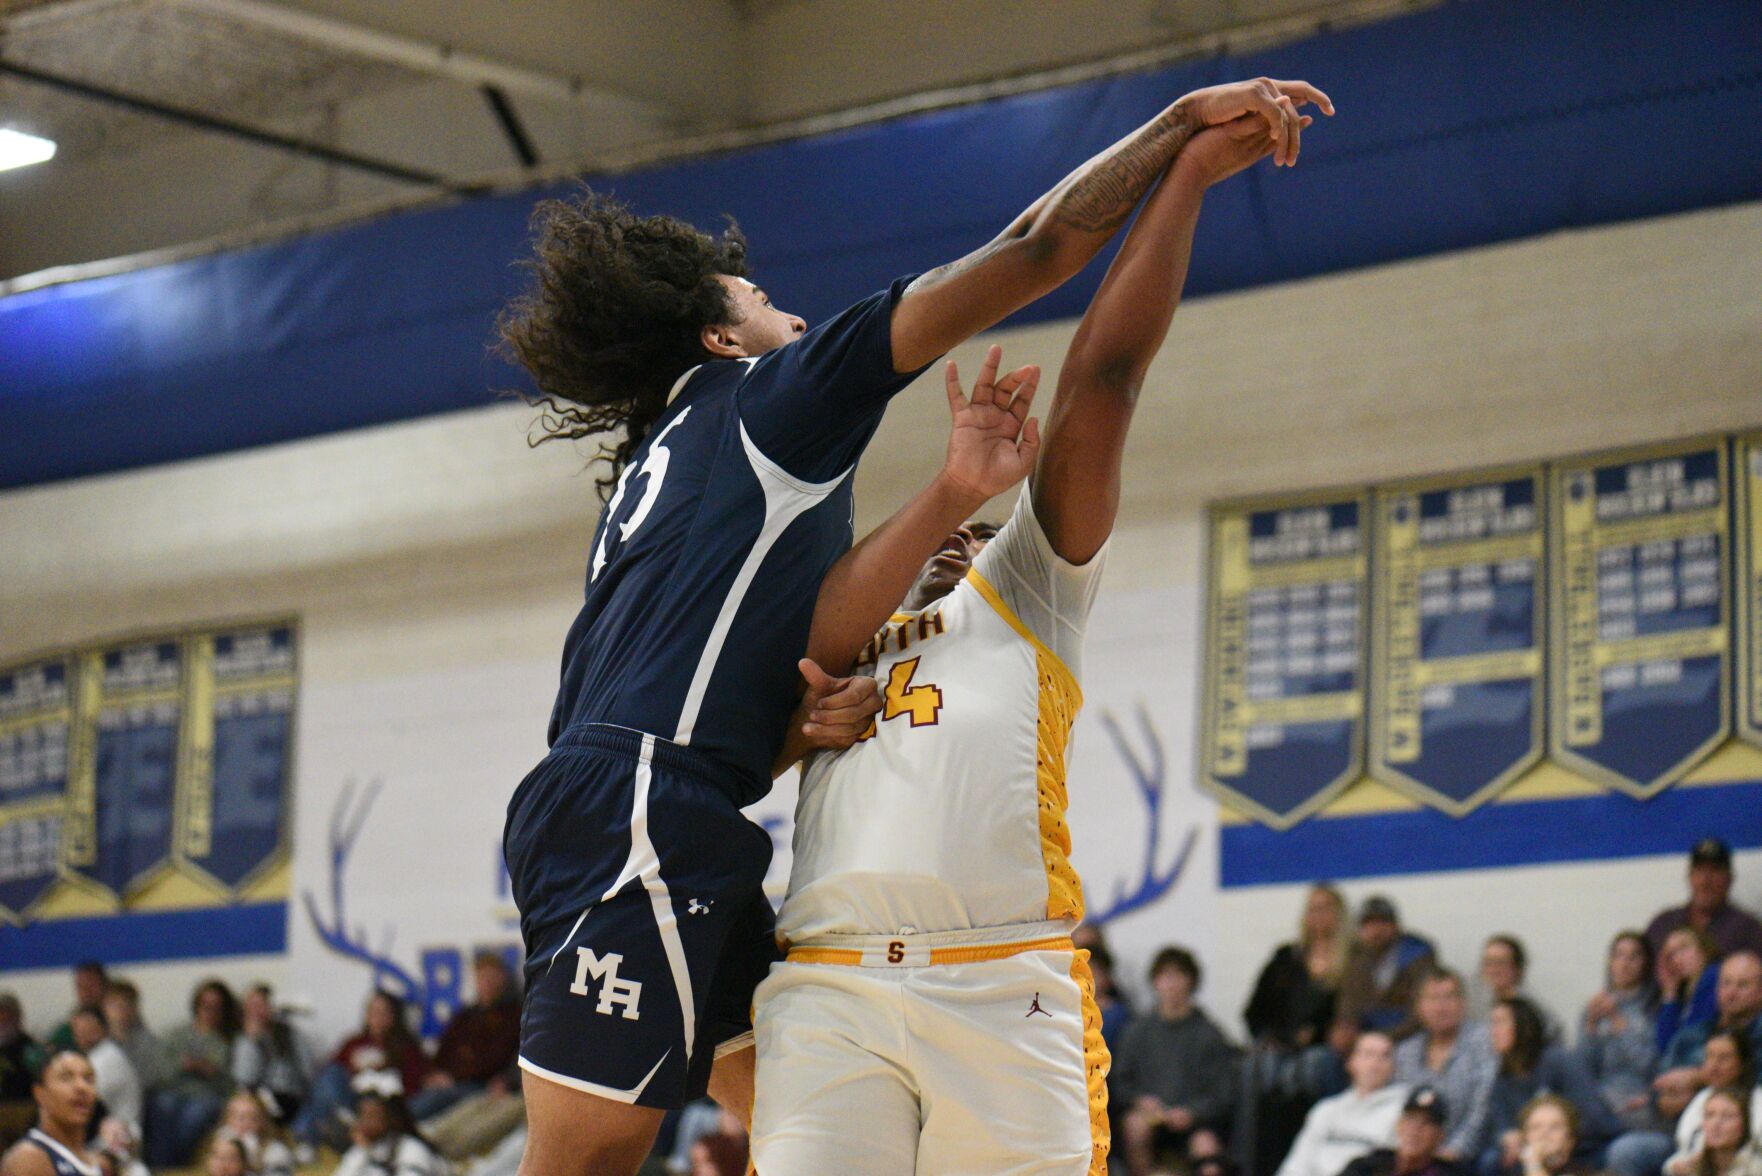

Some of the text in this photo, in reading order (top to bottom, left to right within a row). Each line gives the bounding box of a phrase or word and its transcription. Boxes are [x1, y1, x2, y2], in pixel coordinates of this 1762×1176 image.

[591, 405, 692, 584] 15
[857, 655, 943, 742] 4
[570, 946, 643, 1021] MA
[887, 940, 905, 964] S
